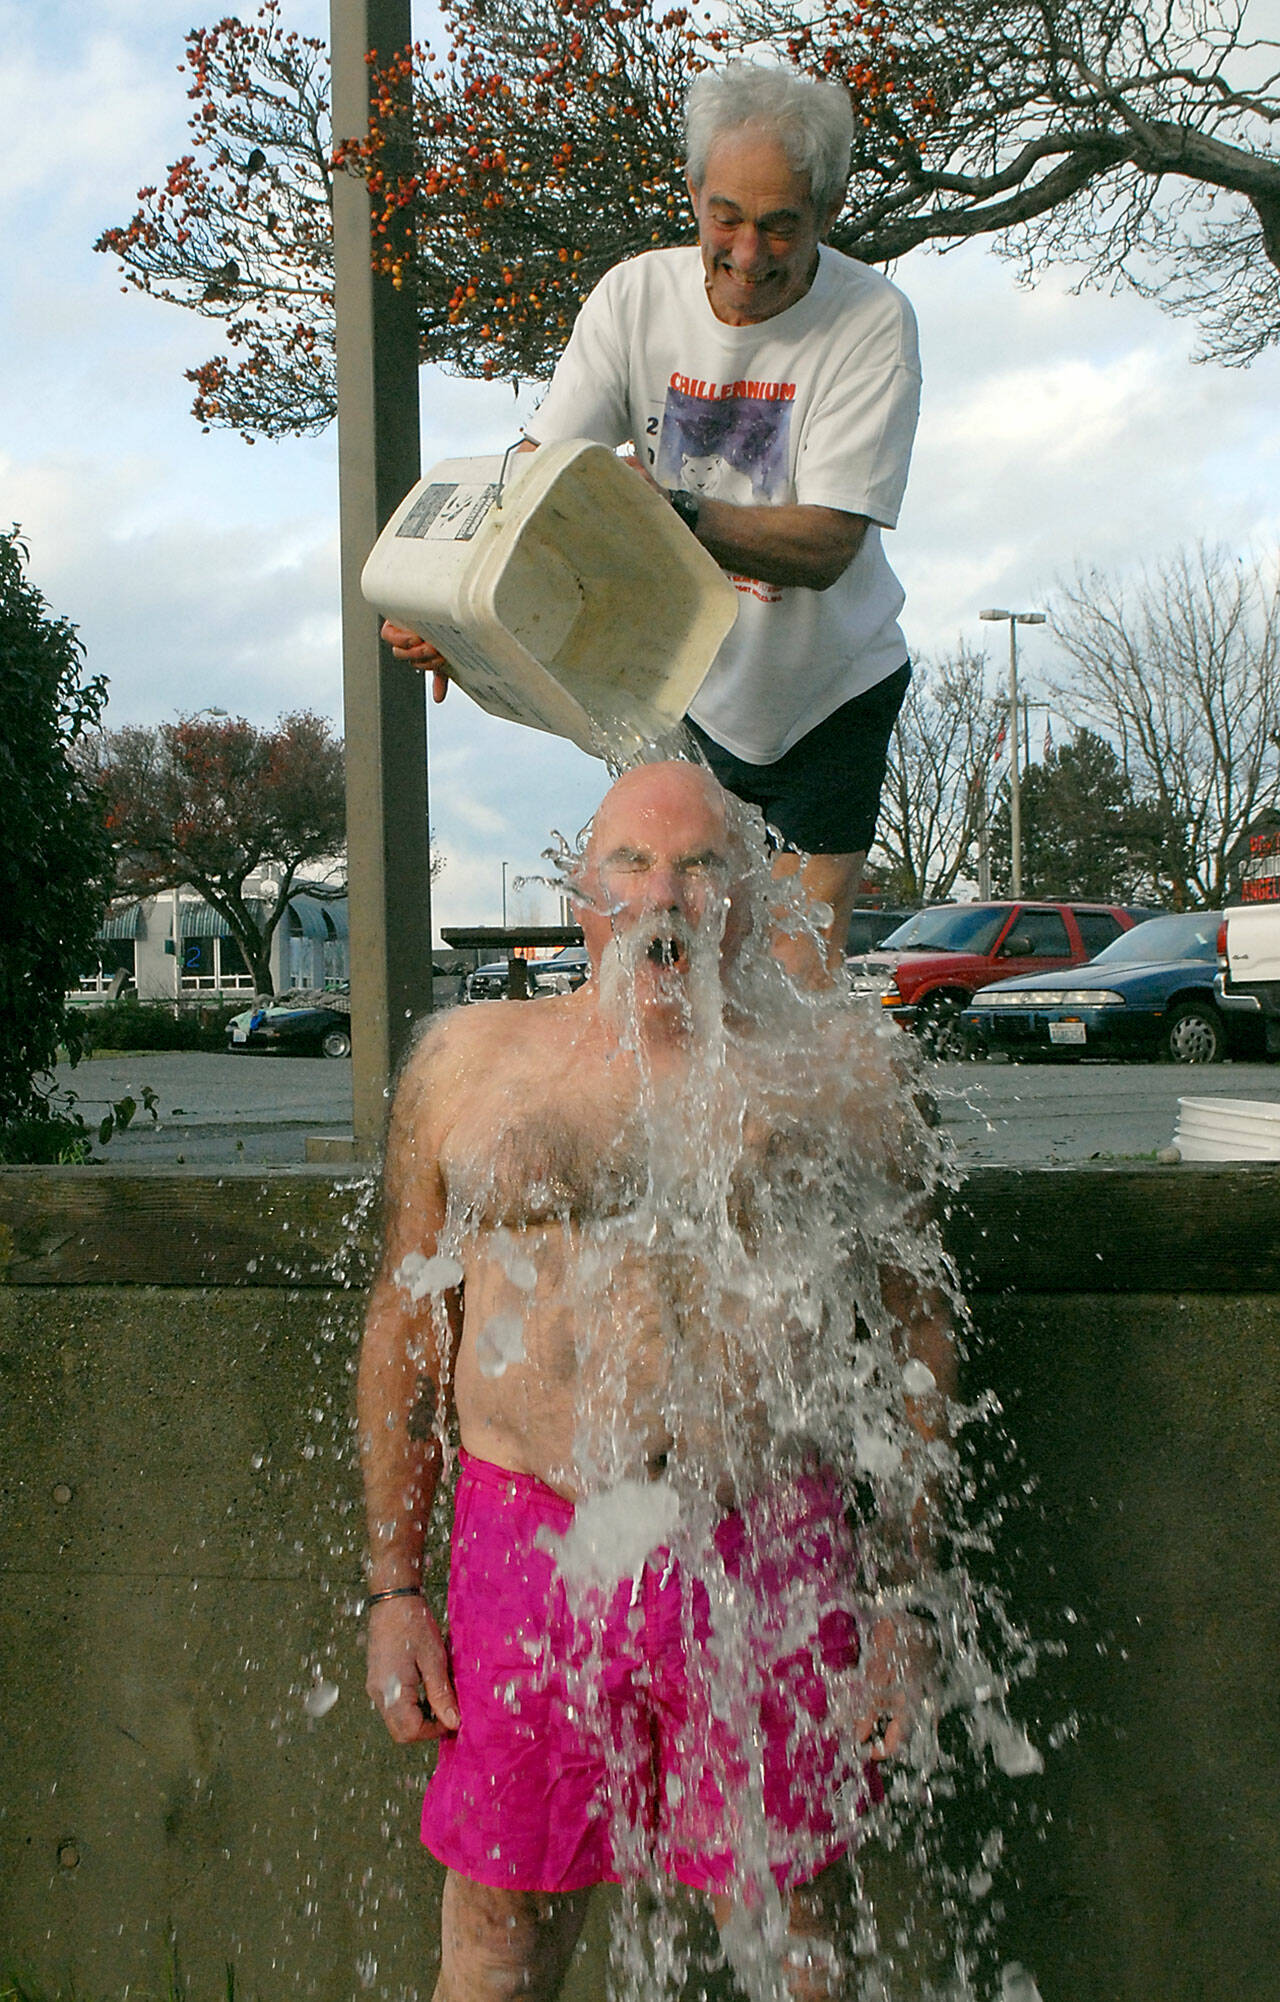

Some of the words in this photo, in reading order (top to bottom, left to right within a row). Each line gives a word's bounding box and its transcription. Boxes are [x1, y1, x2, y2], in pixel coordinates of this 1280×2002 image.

[670, 371, 796, 402] CHILLENNIUM
[646, 416, 659, 436] 2
[1241, 878, 1280, 901] ANGEL
[186, 946, 201, 968] 2
